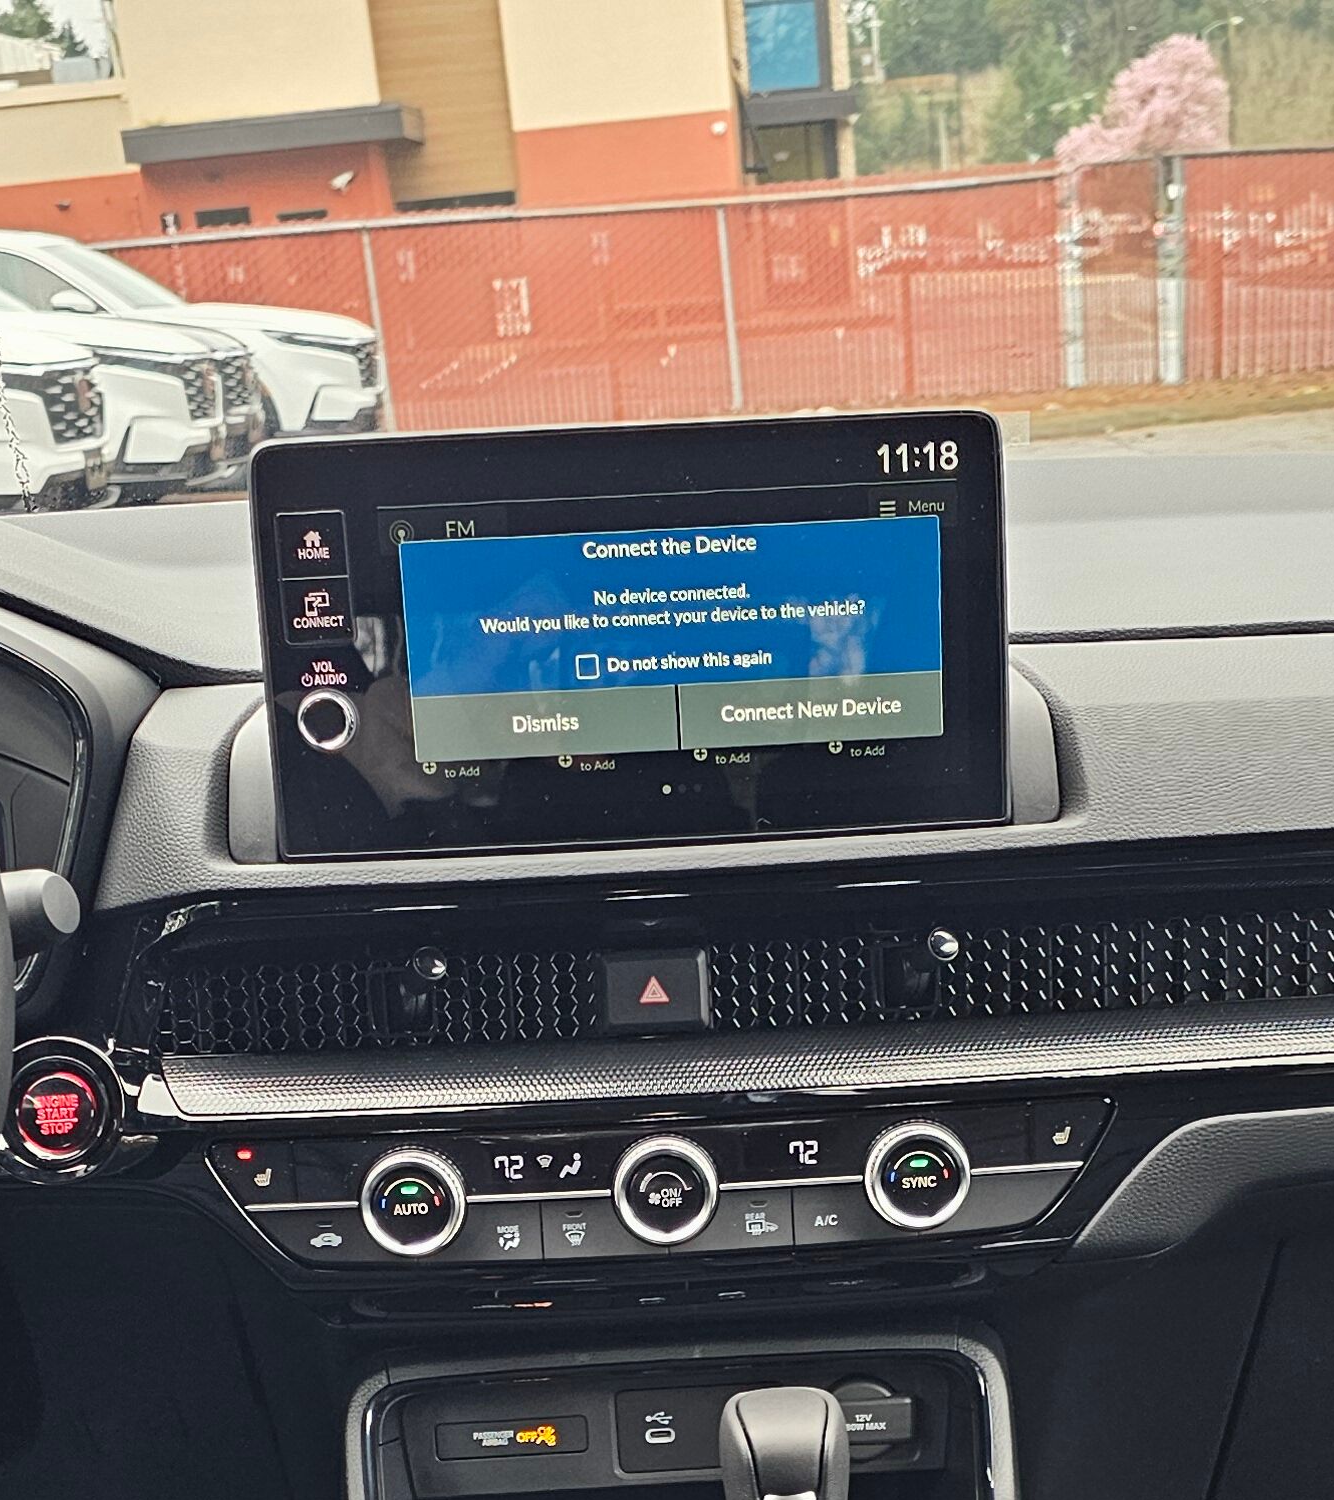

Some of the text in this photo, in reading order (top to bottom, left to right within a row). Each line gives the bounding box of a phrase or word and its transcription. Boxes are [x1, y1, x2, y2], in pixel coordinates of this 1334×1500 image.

[877, 440, 959, 474] 11:18
[908, 500, 945, 513] Menu
[445, 520, 476, 538] FM
[582, 534, 757, 559] Connect the Device
[297, 548, 330, 560] HOME
[593, 583, 751, 606] No device connected.
[293, 615, 345, 629] CONNECT
[480, 599, 866, 634] Would you like to connect your device to the vehicle?
[311, 660, 336, 674] VOL
[607, 650, 772, 673] Do not show this again
[314, 672, 348, 686] AUDIO
[721, 696, 902, 723] Connect New Device
[512, 713, 580, 734] Dismiss
[850, 745, 885, 757] to Add
[580, 759, 616, 772] to Add
[715, 753, 750, 765] to Add
[445, 766, 480, 778] to Add
[33, 1093, 79, 1109] ENGINE
[37, 1107, 76, 1120] START
[40, 1122, 74, 1135] STOP
[789, 1140, 819, 1164] 72
[493, 1155, 524, 1180] 72
[901, 1175, 938, 1191] SYNC
[662, 1198, 683, 1208] OFF
[393, 1203, 429, 1217] AUTO
[745, 1212, 767, 1221] REAR
[562, 1222, 587, 1232] FRONT
[814, 1214, 839, 1227] A/C
[496, 1225, 519, 1234] MODE
[854, 1414, 873, 1422] 12V
[866, 1422, 887, 1431] MAX
[516, 1431, 538, 1443] OFF
